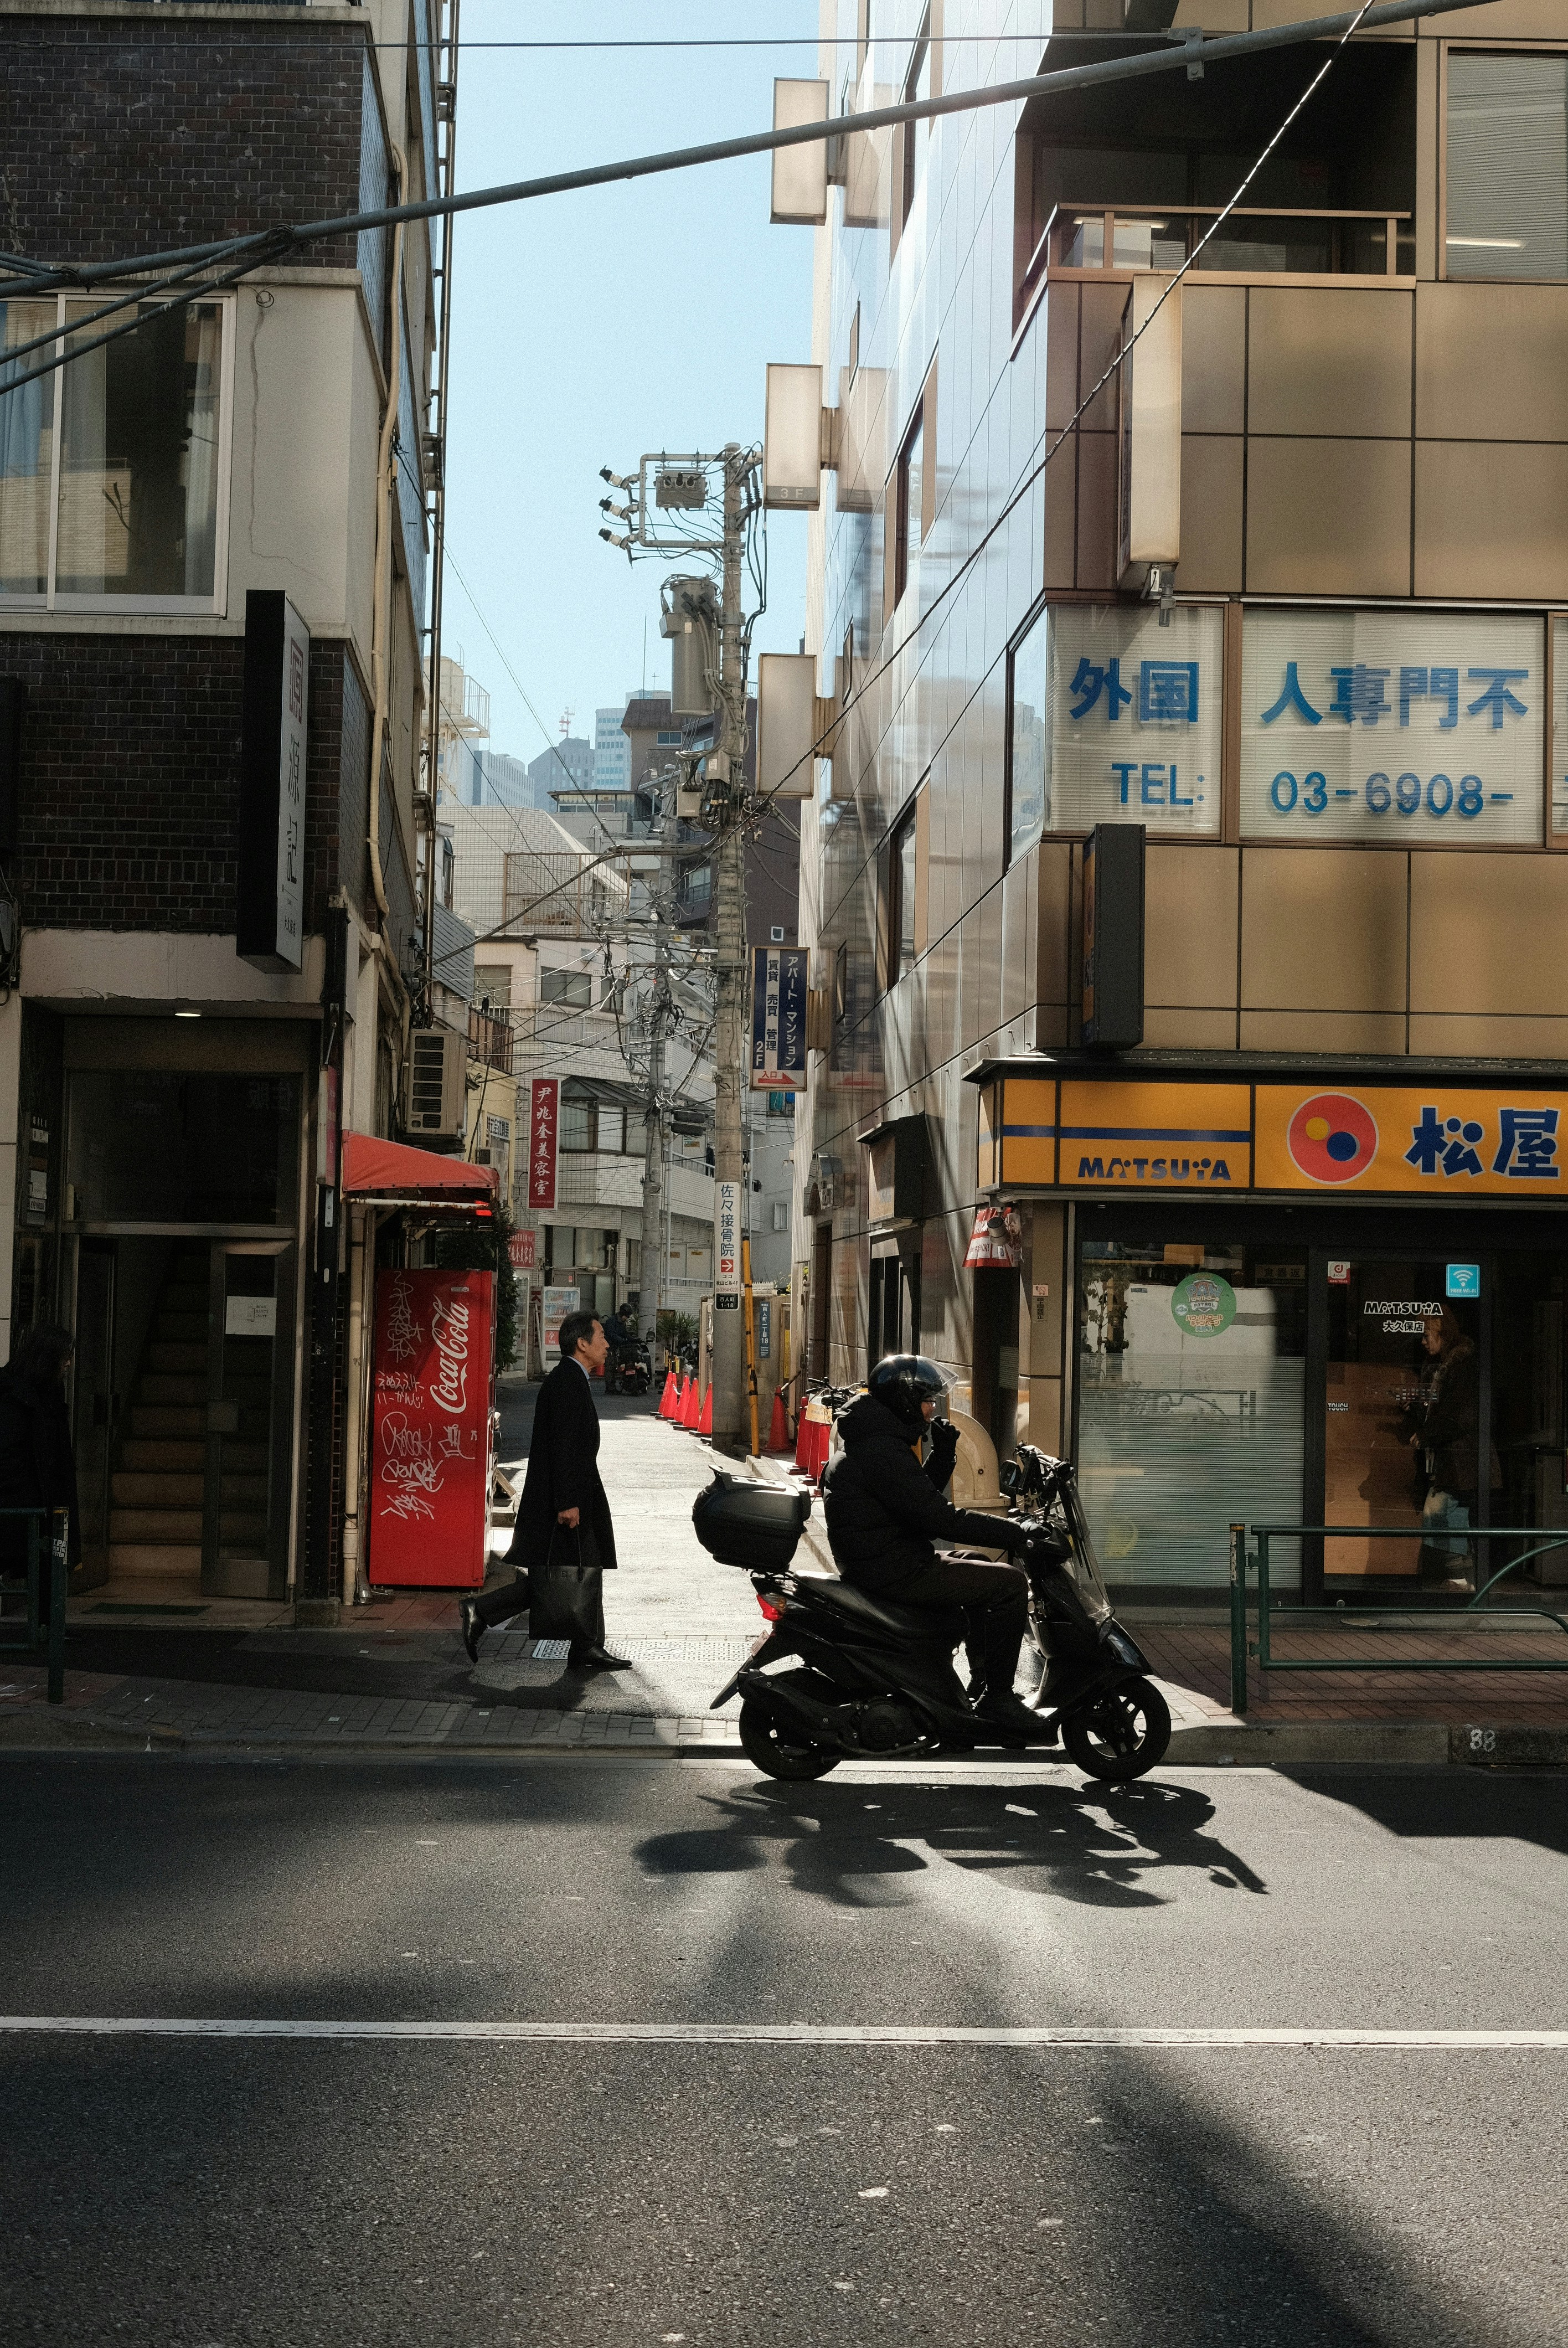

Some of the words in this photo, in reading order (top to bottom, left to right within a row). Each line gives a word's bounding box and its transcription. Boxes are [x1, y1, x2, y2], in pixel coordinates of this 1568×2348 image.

[780, 488, 804, 499] 3F
[1069, 657, 1200, 724] 外国
[1260, 661, 1530, 730] 人専門不
[1111, 763, 1206, 806] TEL:
[1271, 771, 1514, 817] 03-6908-
[767, 993, 778, 1016] 売買
[785, 956, 798, 1067] アパート・マンション
[766, 1028, 777, 1051] 管理
[756, 1041, 764, 1066] 2F
[1404, 1105, 1561, 1178] 松屋
[720, 1184, 734, 1257] 佐々接骨院
[1383, 1320, 1425, 1333] 大久保店
[430, 1294, 470, 1414] Coca-Cola
[1328, 1403, 1348, 1411] TOUCH
[1469, 1728, 1496, 1752] 88
